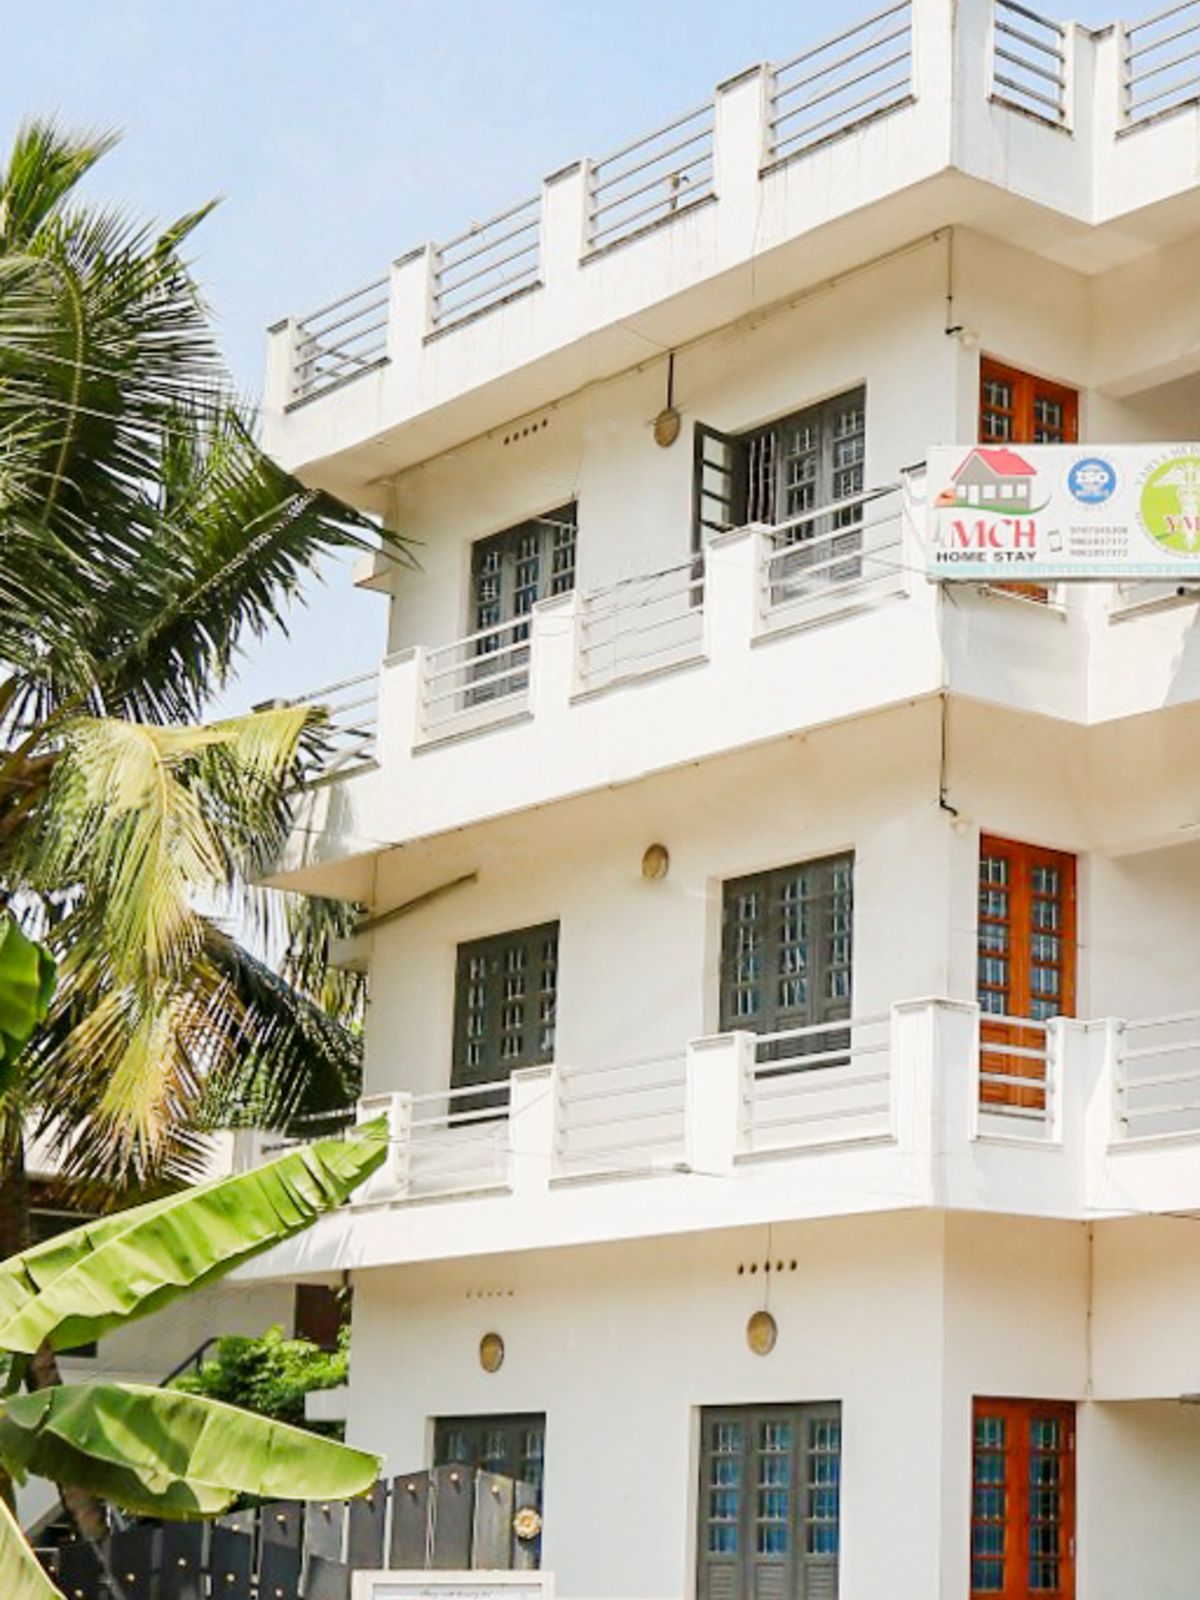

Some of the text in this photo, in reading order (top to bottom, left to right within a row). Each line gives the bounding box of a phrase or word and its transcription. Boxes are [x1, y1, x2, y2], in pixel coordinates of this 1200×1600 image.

[950, 518, 1037, 548] MCH
[936, 551, 1037, 564] HOME STAY
